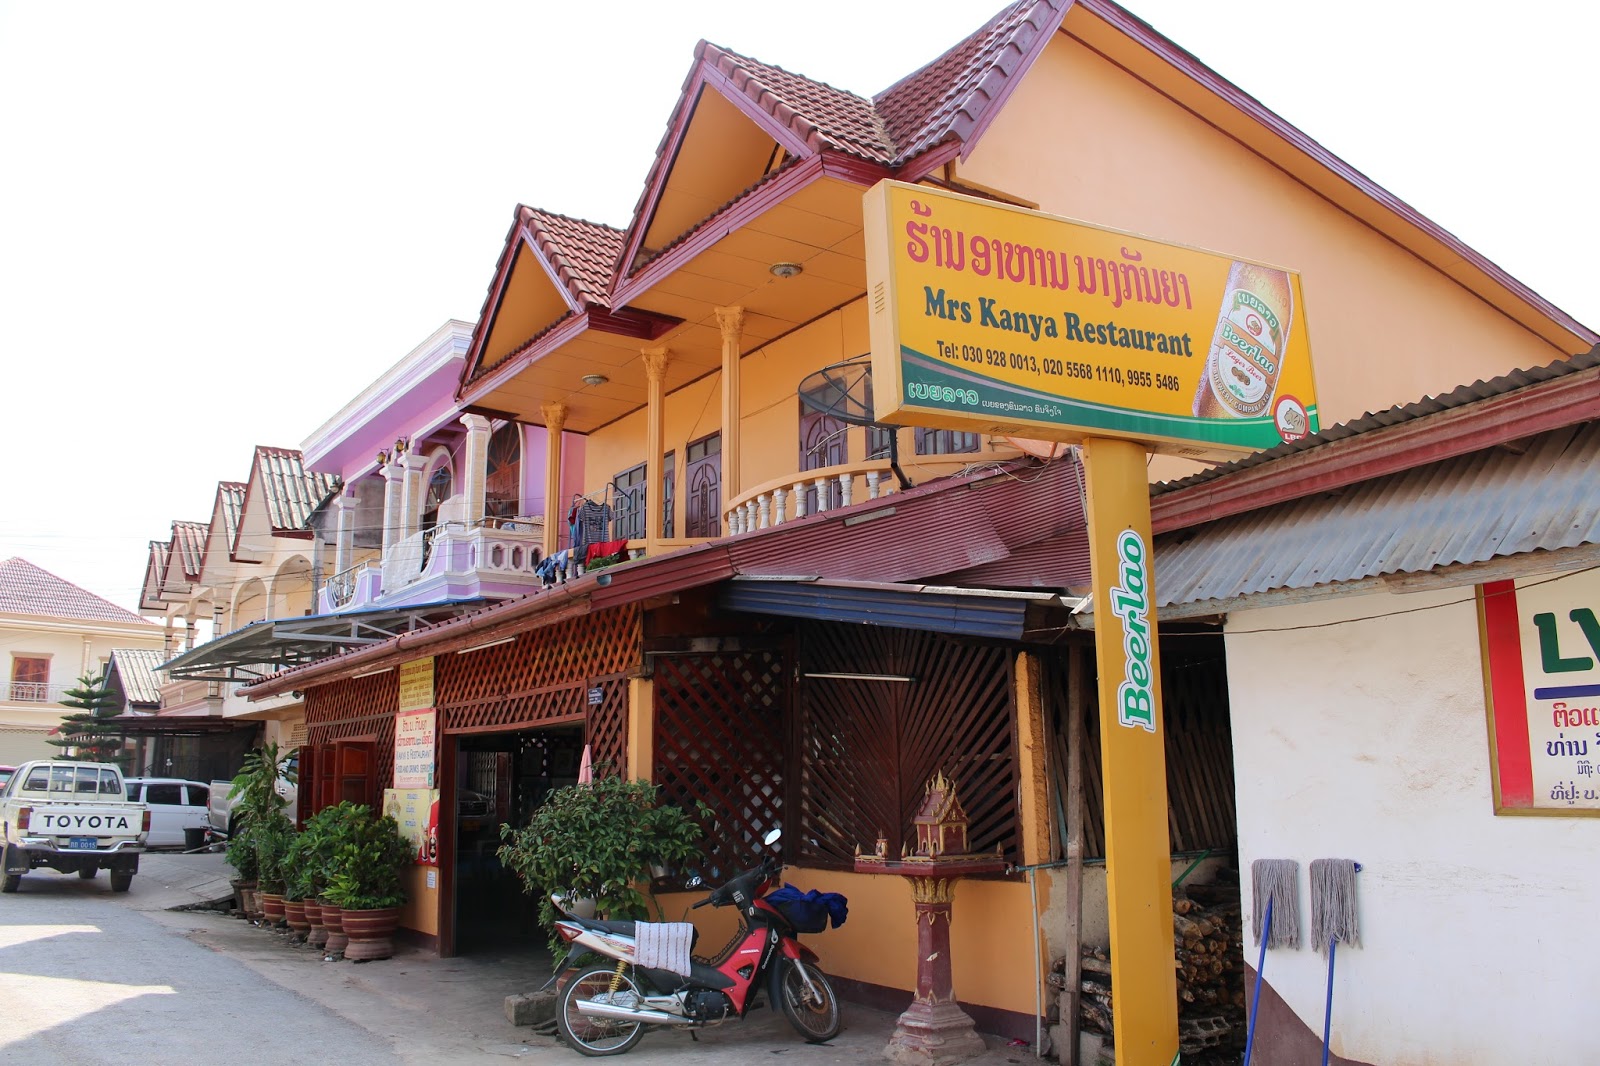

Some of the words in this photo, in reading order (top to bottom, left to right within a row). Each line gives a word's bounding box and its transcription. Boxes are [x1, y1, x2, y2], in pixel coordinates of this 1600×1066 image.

[906, 200, 965, 272] ຮ້ານ
[923, 286, 972, 324] Mrs
[978, 297, 1058, 342] Kanya
[1063, 311, 1193, 358] Restaurant
[1221, 322, 1276, 375] Beerlao
[936, 340, 959, 360] Tel:
[962, 344, 983, 364] 030
[986, 348, 1007, 368] 928
[1009, 353, 1041, 376] 0013,
[1043, 358, 1063, 376] 020
[1066, 361, 1093, 380] 5568
[1095, 365, 1125, 387] 1110,
[1127, 369, 1152, 388] 9955
[1155, 373, 1180, 392] 5486
[1225, 350, 1246, 368] Lager
[1246, 366, 1262, 382] Beer
[908, 382, 979, 406] ເບຍລາວ
[1234, 401, 1261, 413] COMPANY
[1112, 530, 1155, 731] Beerlao
[1553, 702, 1600, 728] ຕົວແ
[1546, 732, 1588, 757] ທ່ານ
[1584, 789, 1600, 800] ບ.
[43, 815, 129, 829] TOYOTA
[80, 841, 96, 849] 0015
